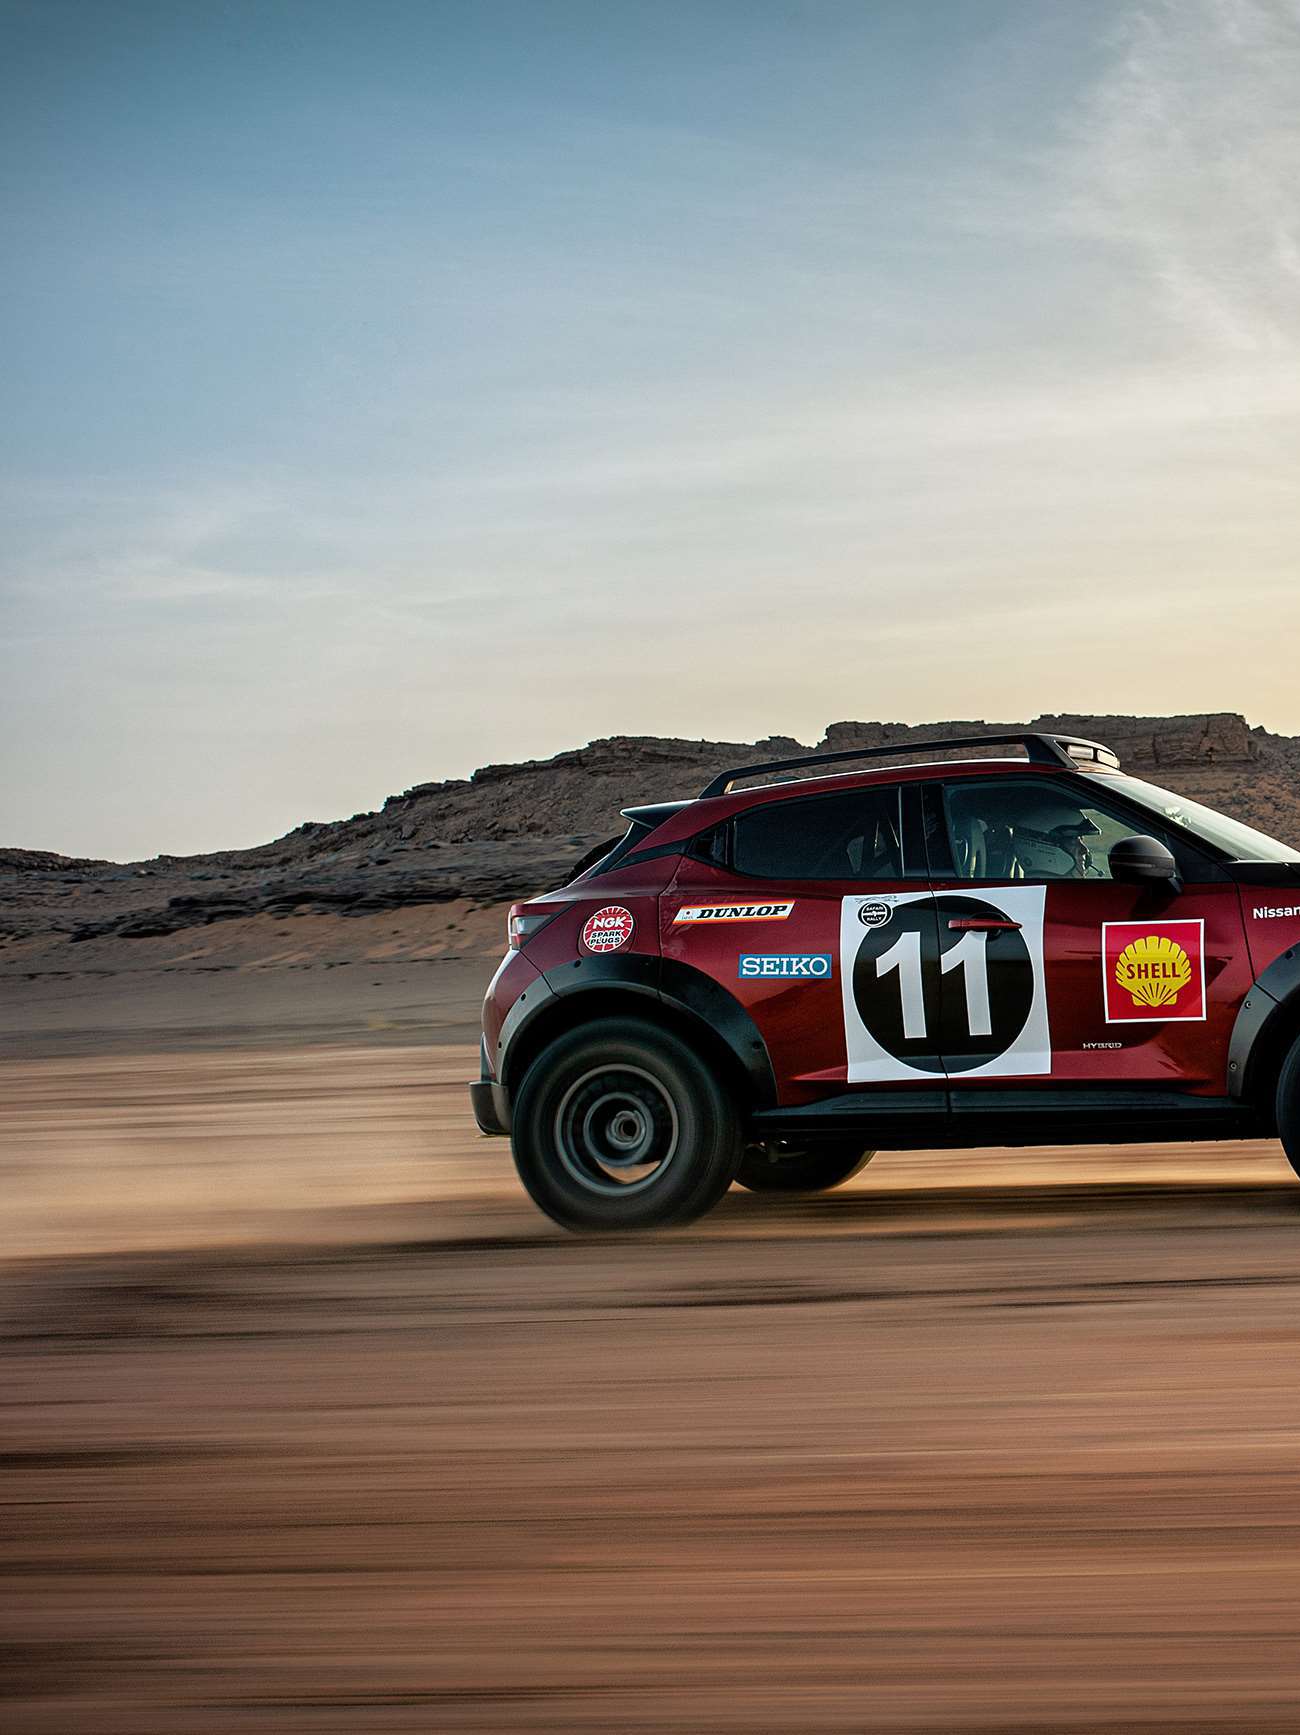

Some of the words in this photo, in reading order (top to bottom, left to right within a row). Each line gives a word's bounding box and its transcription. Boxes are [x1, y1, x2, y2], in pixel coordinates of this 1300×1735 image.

[696, 905, 787, 919] DUNLOP
[592, 916, 626, 929] NGK
[742, 957, 828, 976] SEIKO
[1126, 962, 1181, 980] SHELL
[876, 931, 992, 1039] 11
